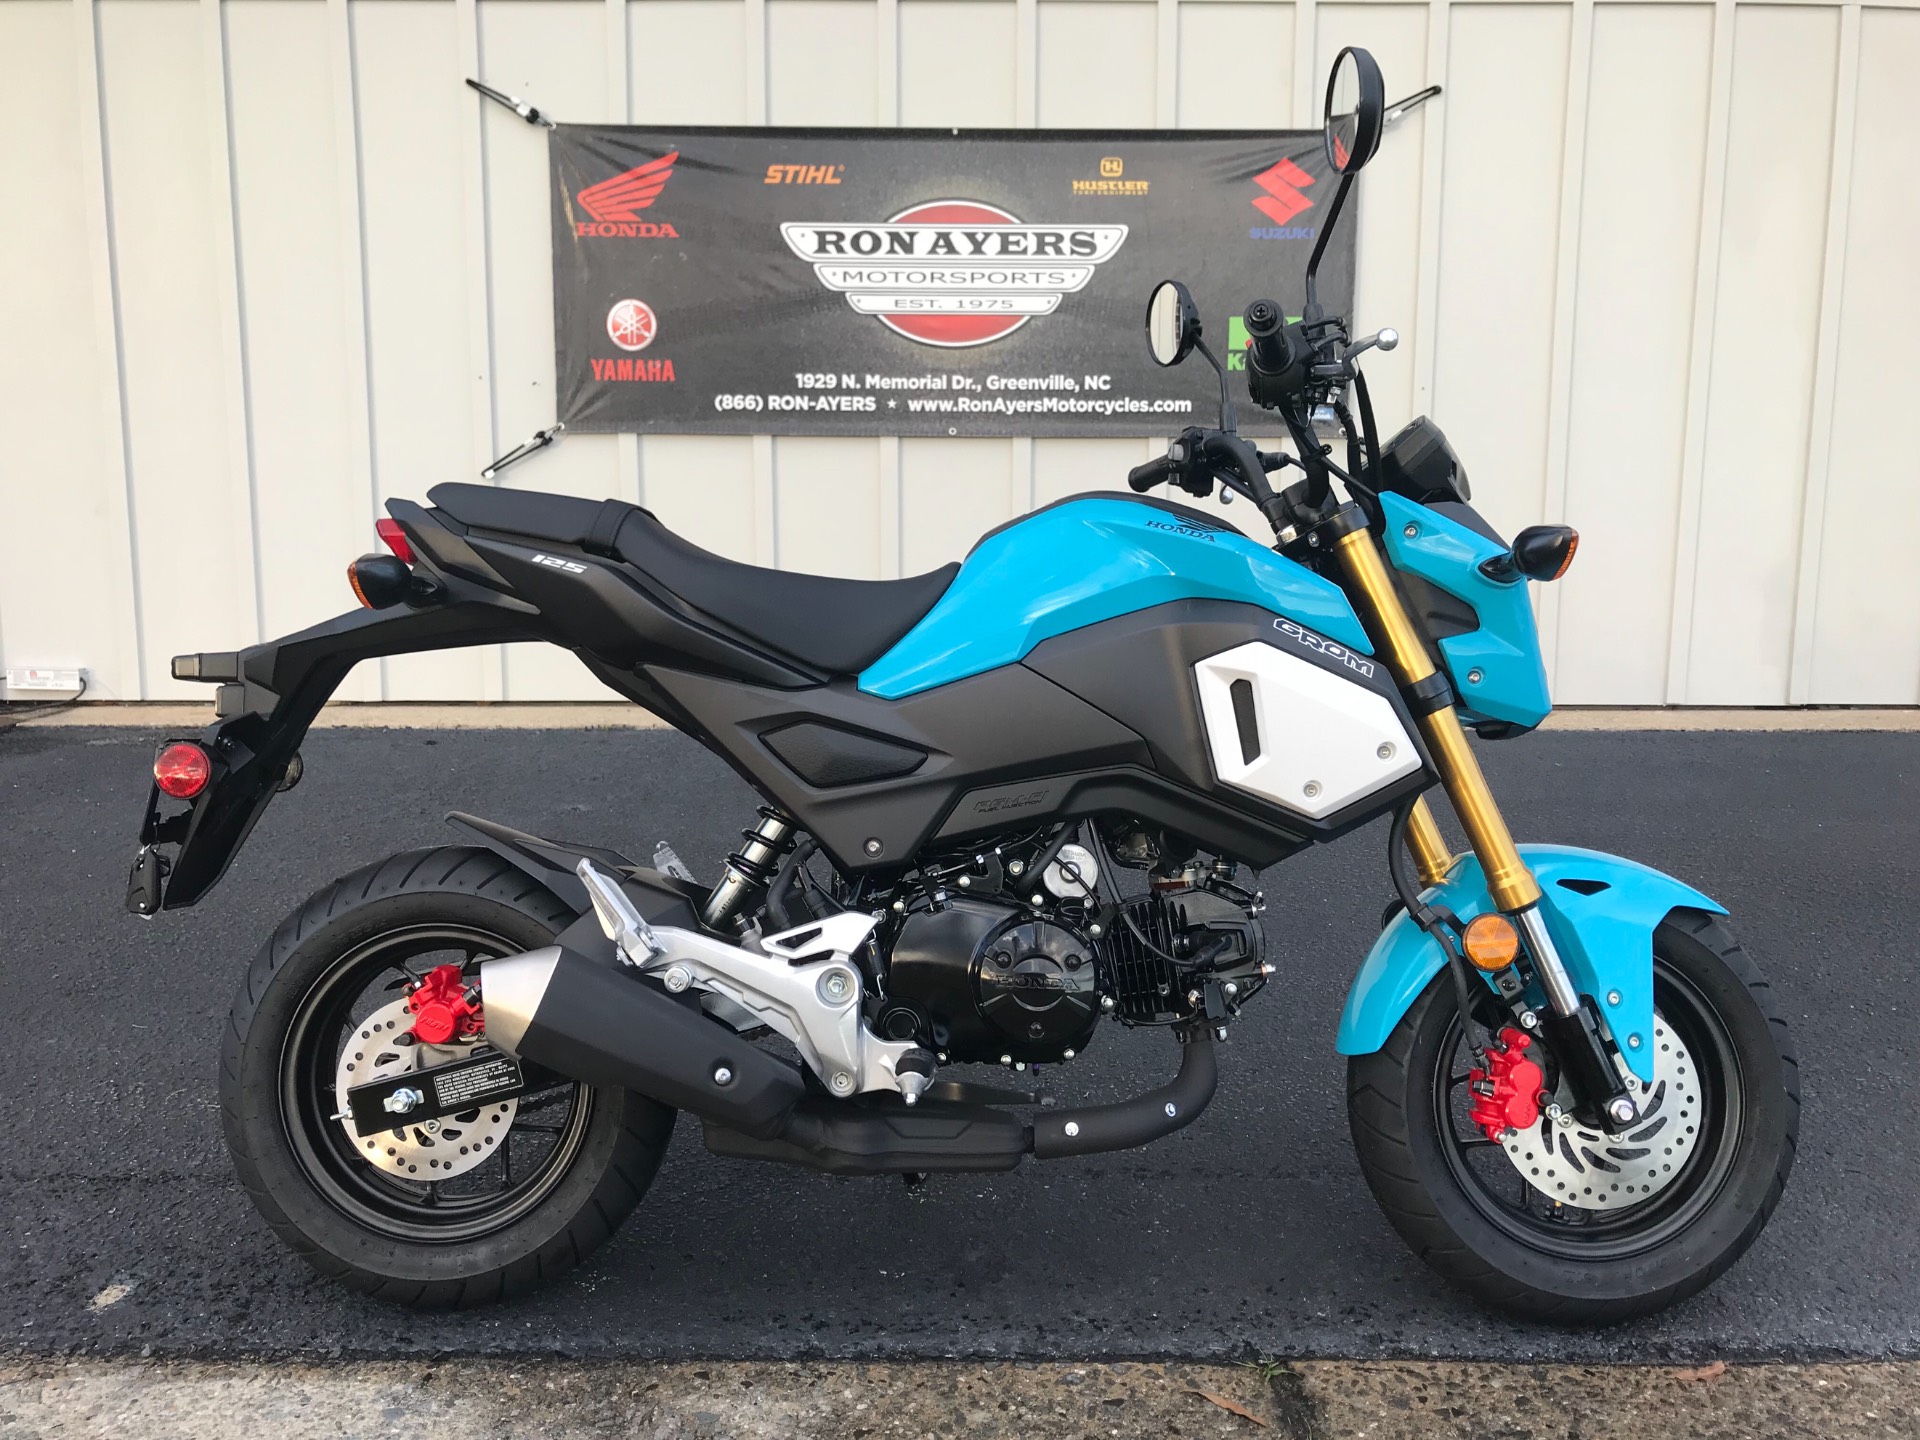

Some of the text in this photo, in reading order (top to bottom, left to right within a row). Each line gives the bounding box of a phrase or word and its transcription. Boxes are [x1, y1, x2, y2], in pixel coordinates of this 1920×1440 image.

[764, 164, 841, 184] STIHL
[1072, 181, 1149, 190] HUSTLER
[576, 222, 680, 238] HONDA
[1249, 227, 1314, 239] SUZUKI
[812, 230, 1098, 257] RON AYERS
[843, 271, 1066, 284] MOTORSPORTS
[894, 299, 1013, 309] EST. 1975
[591, 358, 675, 382] YAMAHA
[795, 373, 1111, 393] 1929 N. Memorial Dr., Greenville, NC
[714, 394, 1192, 415] (866) RON-AYERS www.RonAyersMotorcycles.com
[1145, 520, 1216, 542] HONDA
[531, 554, 588, 574] 125
[1273, 618, 1374, 678] GROM
[996, 975, 1080, 991] HONDA
